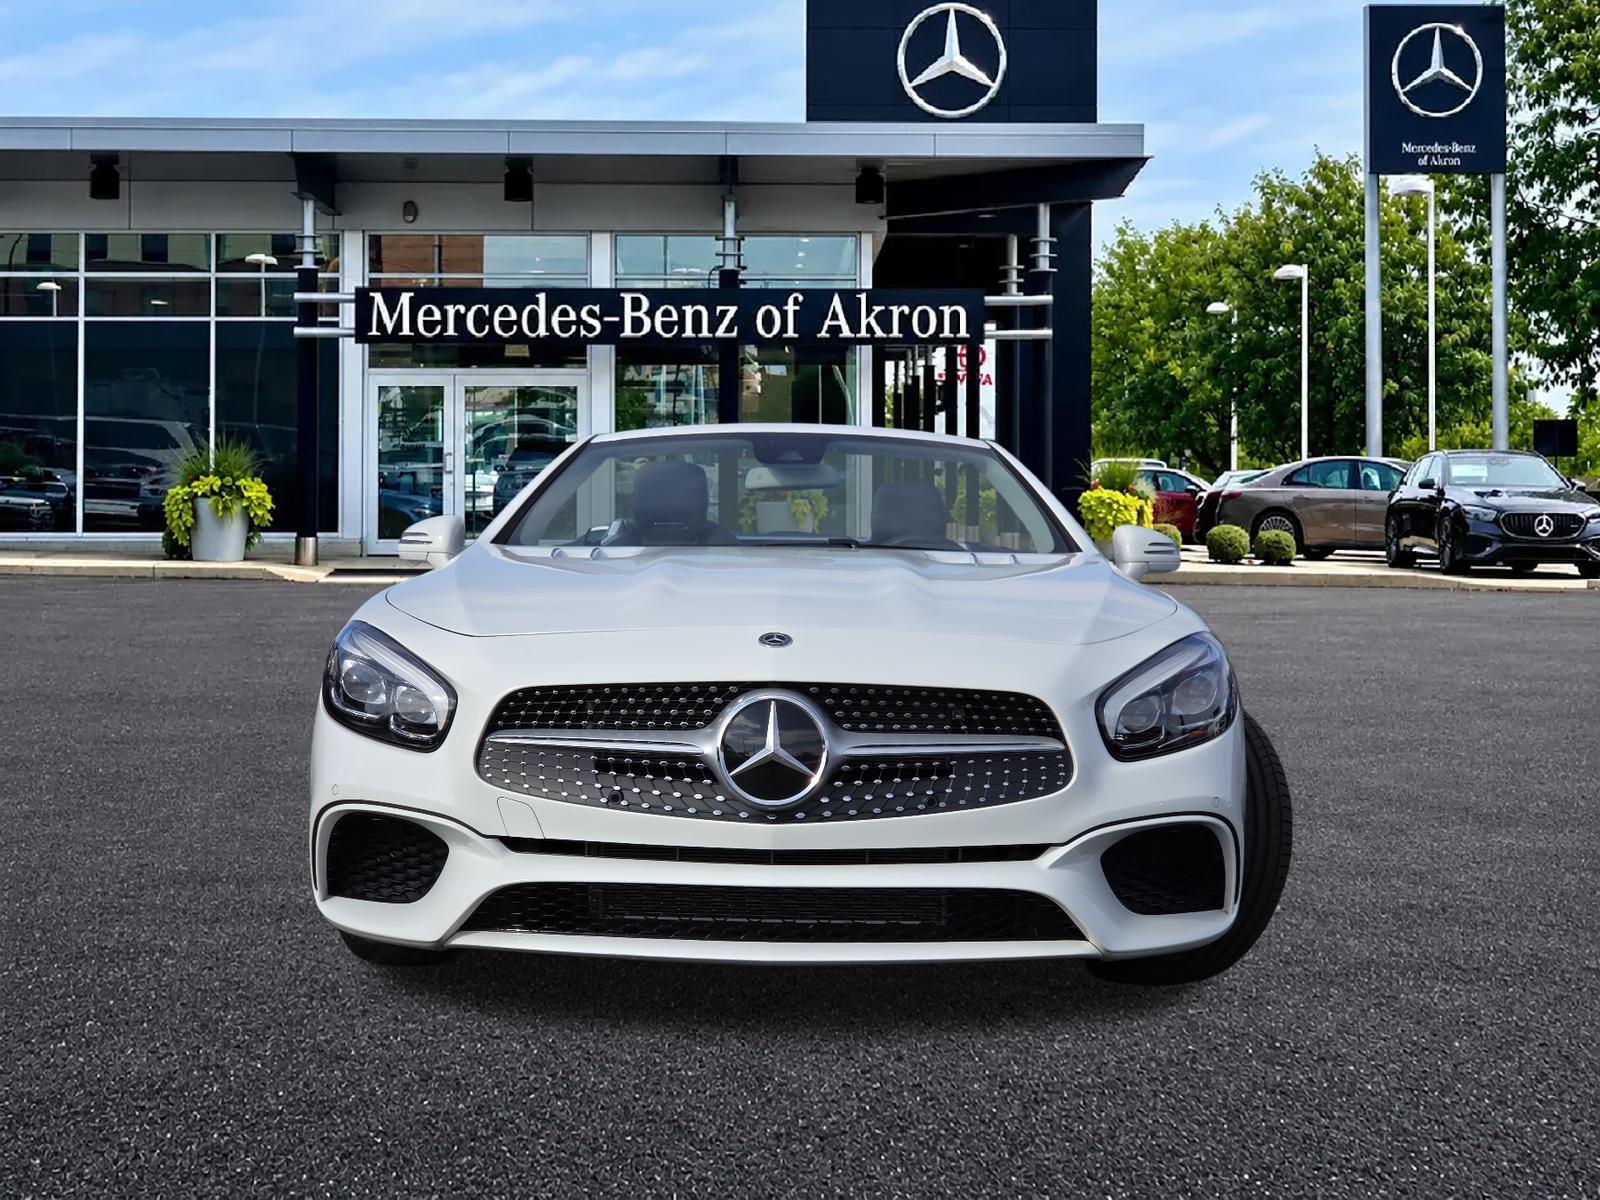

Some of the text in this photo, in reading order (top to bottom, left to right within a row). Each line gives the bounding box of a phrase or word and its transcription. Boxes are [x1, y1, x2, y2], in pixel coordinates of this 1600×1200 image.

[1401, 141, 1476, 153] Mercedes-Benz
[1417, 154, 1461, 166] of Akron
[367, 292, 971, 338] Mercedes-Benz of Akron
